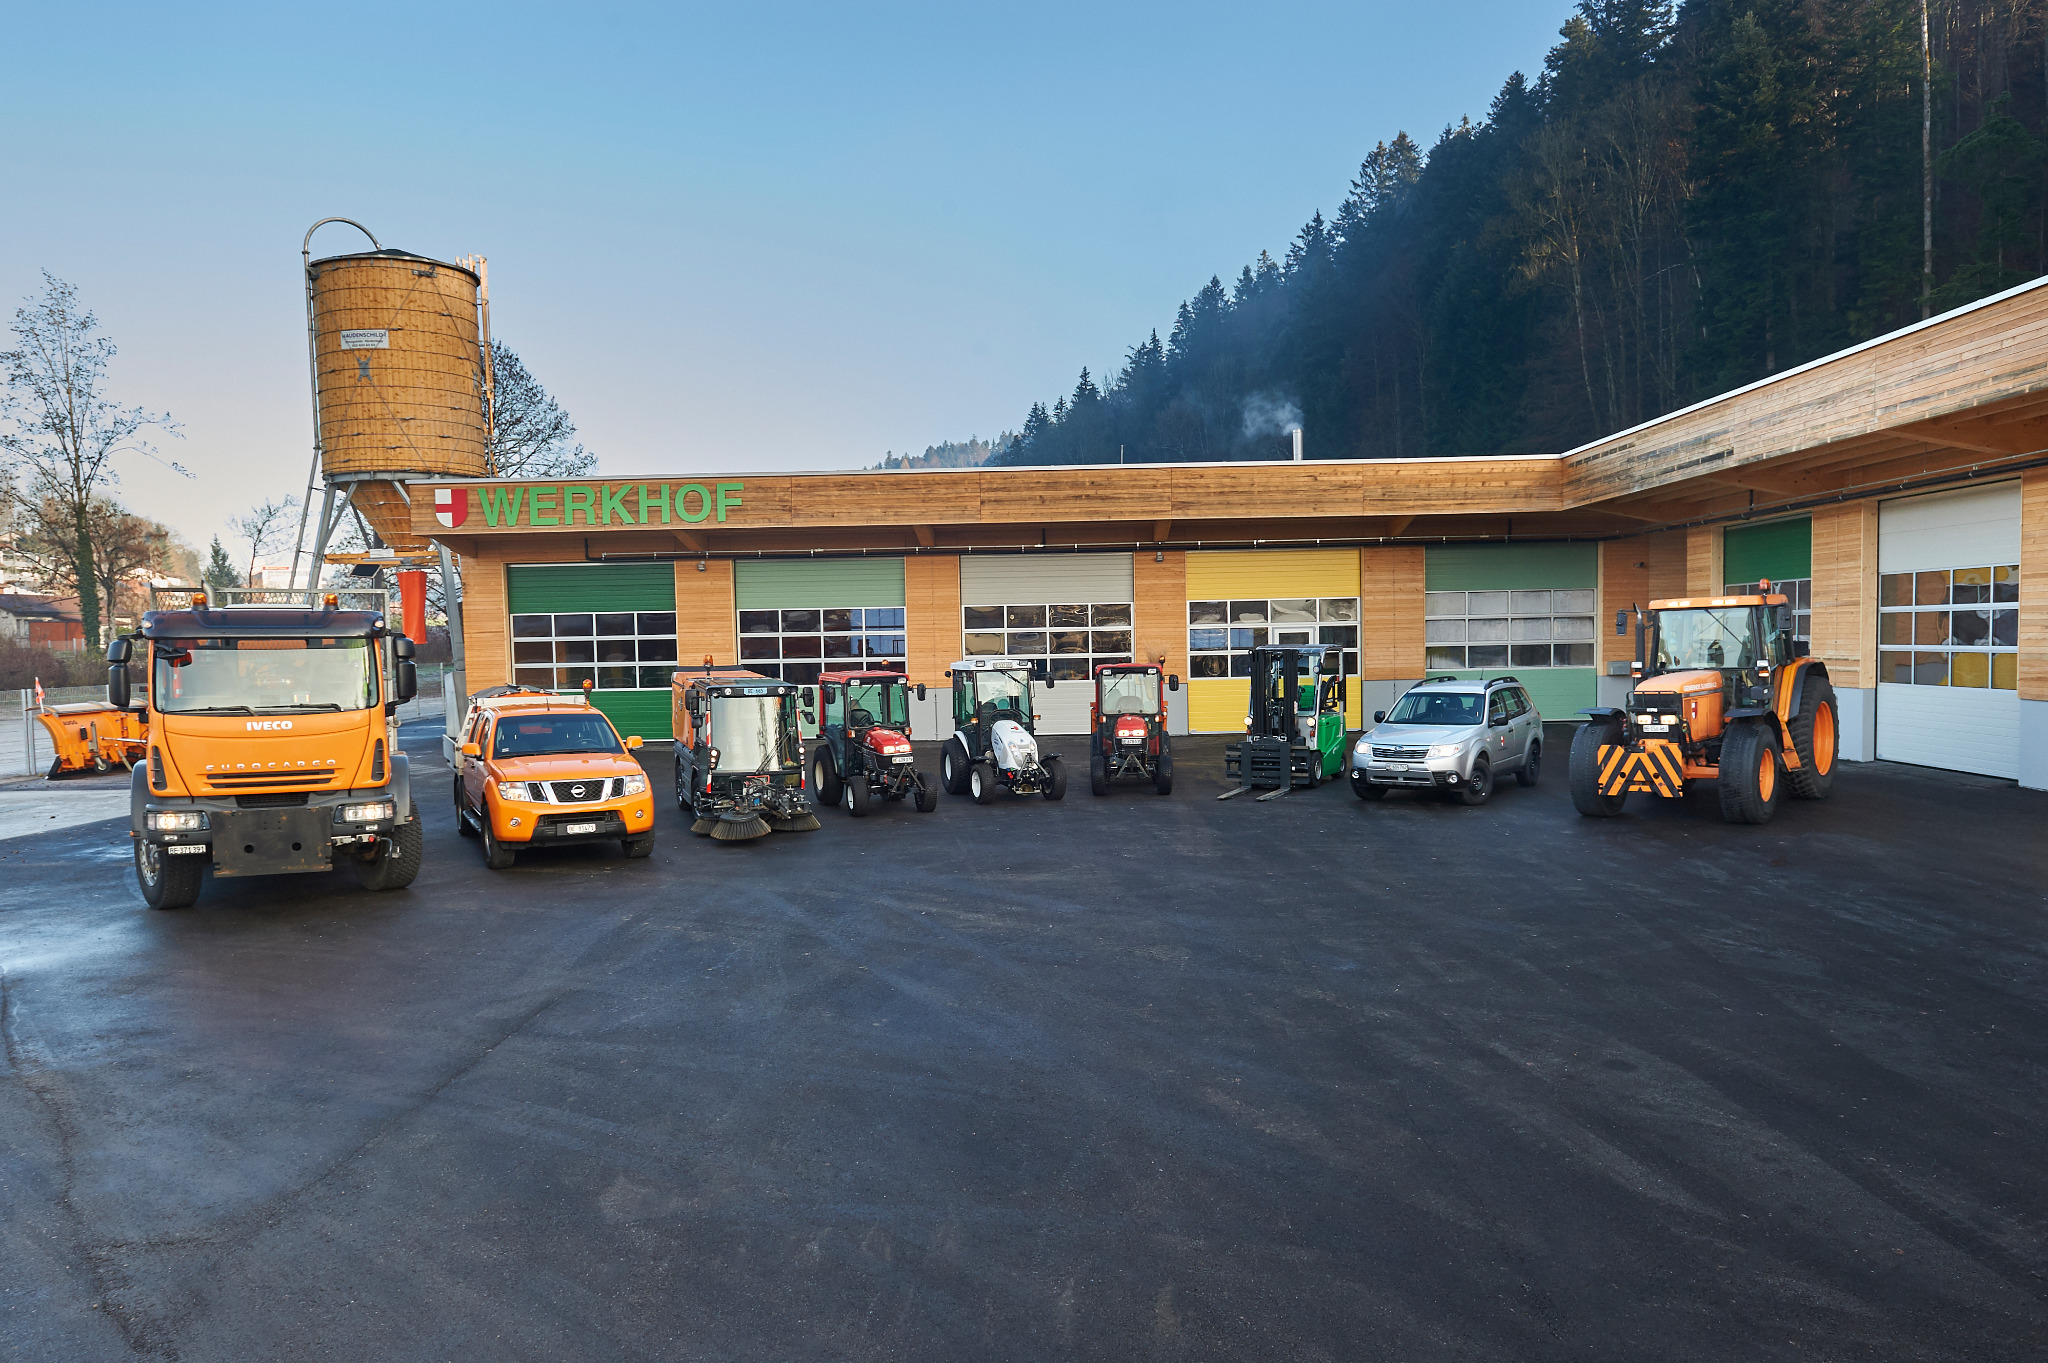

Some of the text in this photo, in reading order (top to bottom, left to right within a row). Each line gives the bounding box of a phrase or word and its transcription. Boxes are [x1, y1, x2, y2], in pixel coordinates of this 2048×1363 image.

[477, 482, 744, 527] WERKHOF
[246, 720, 293, 731] IVECO
[205, 759, 336, 771] EUROCARGO
